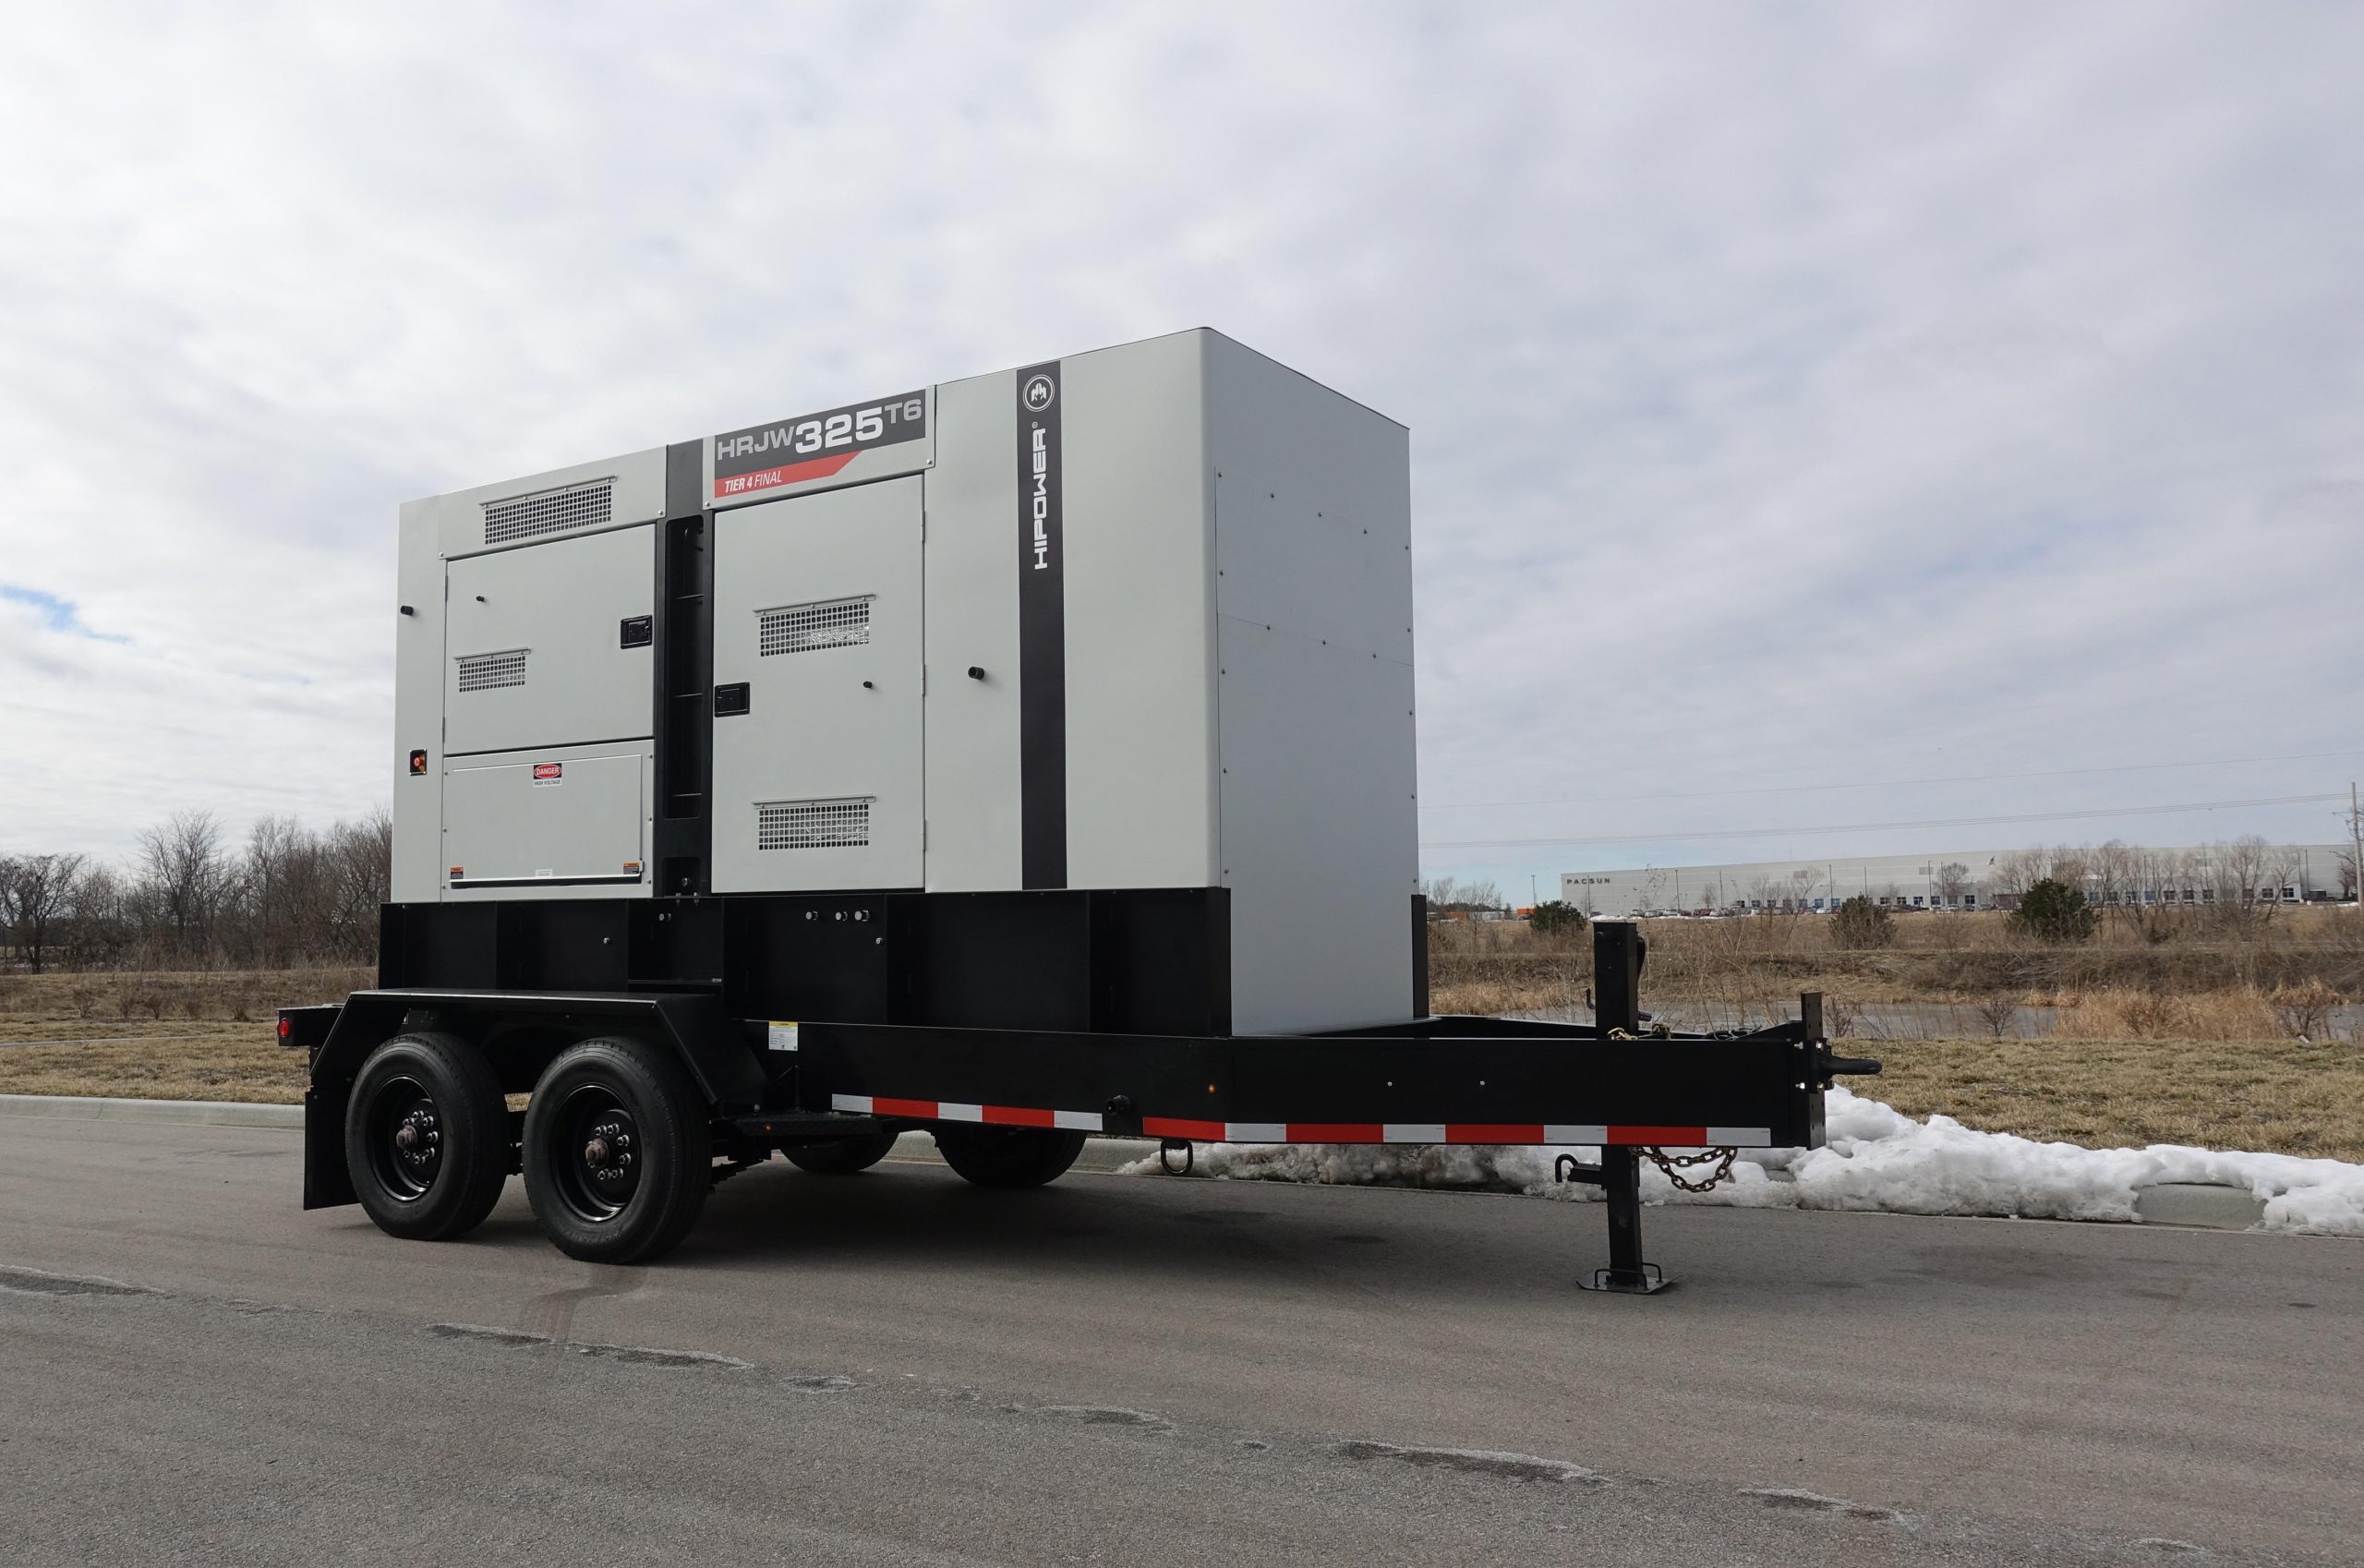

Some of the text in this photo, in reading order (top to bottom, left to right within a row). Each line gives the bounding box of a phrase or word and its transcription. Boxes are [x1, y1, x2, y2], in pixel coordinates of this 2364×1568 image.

[725, 470, 783, 493] TIER 4 FINAL
[536, 767, 560, 776] DANGER
